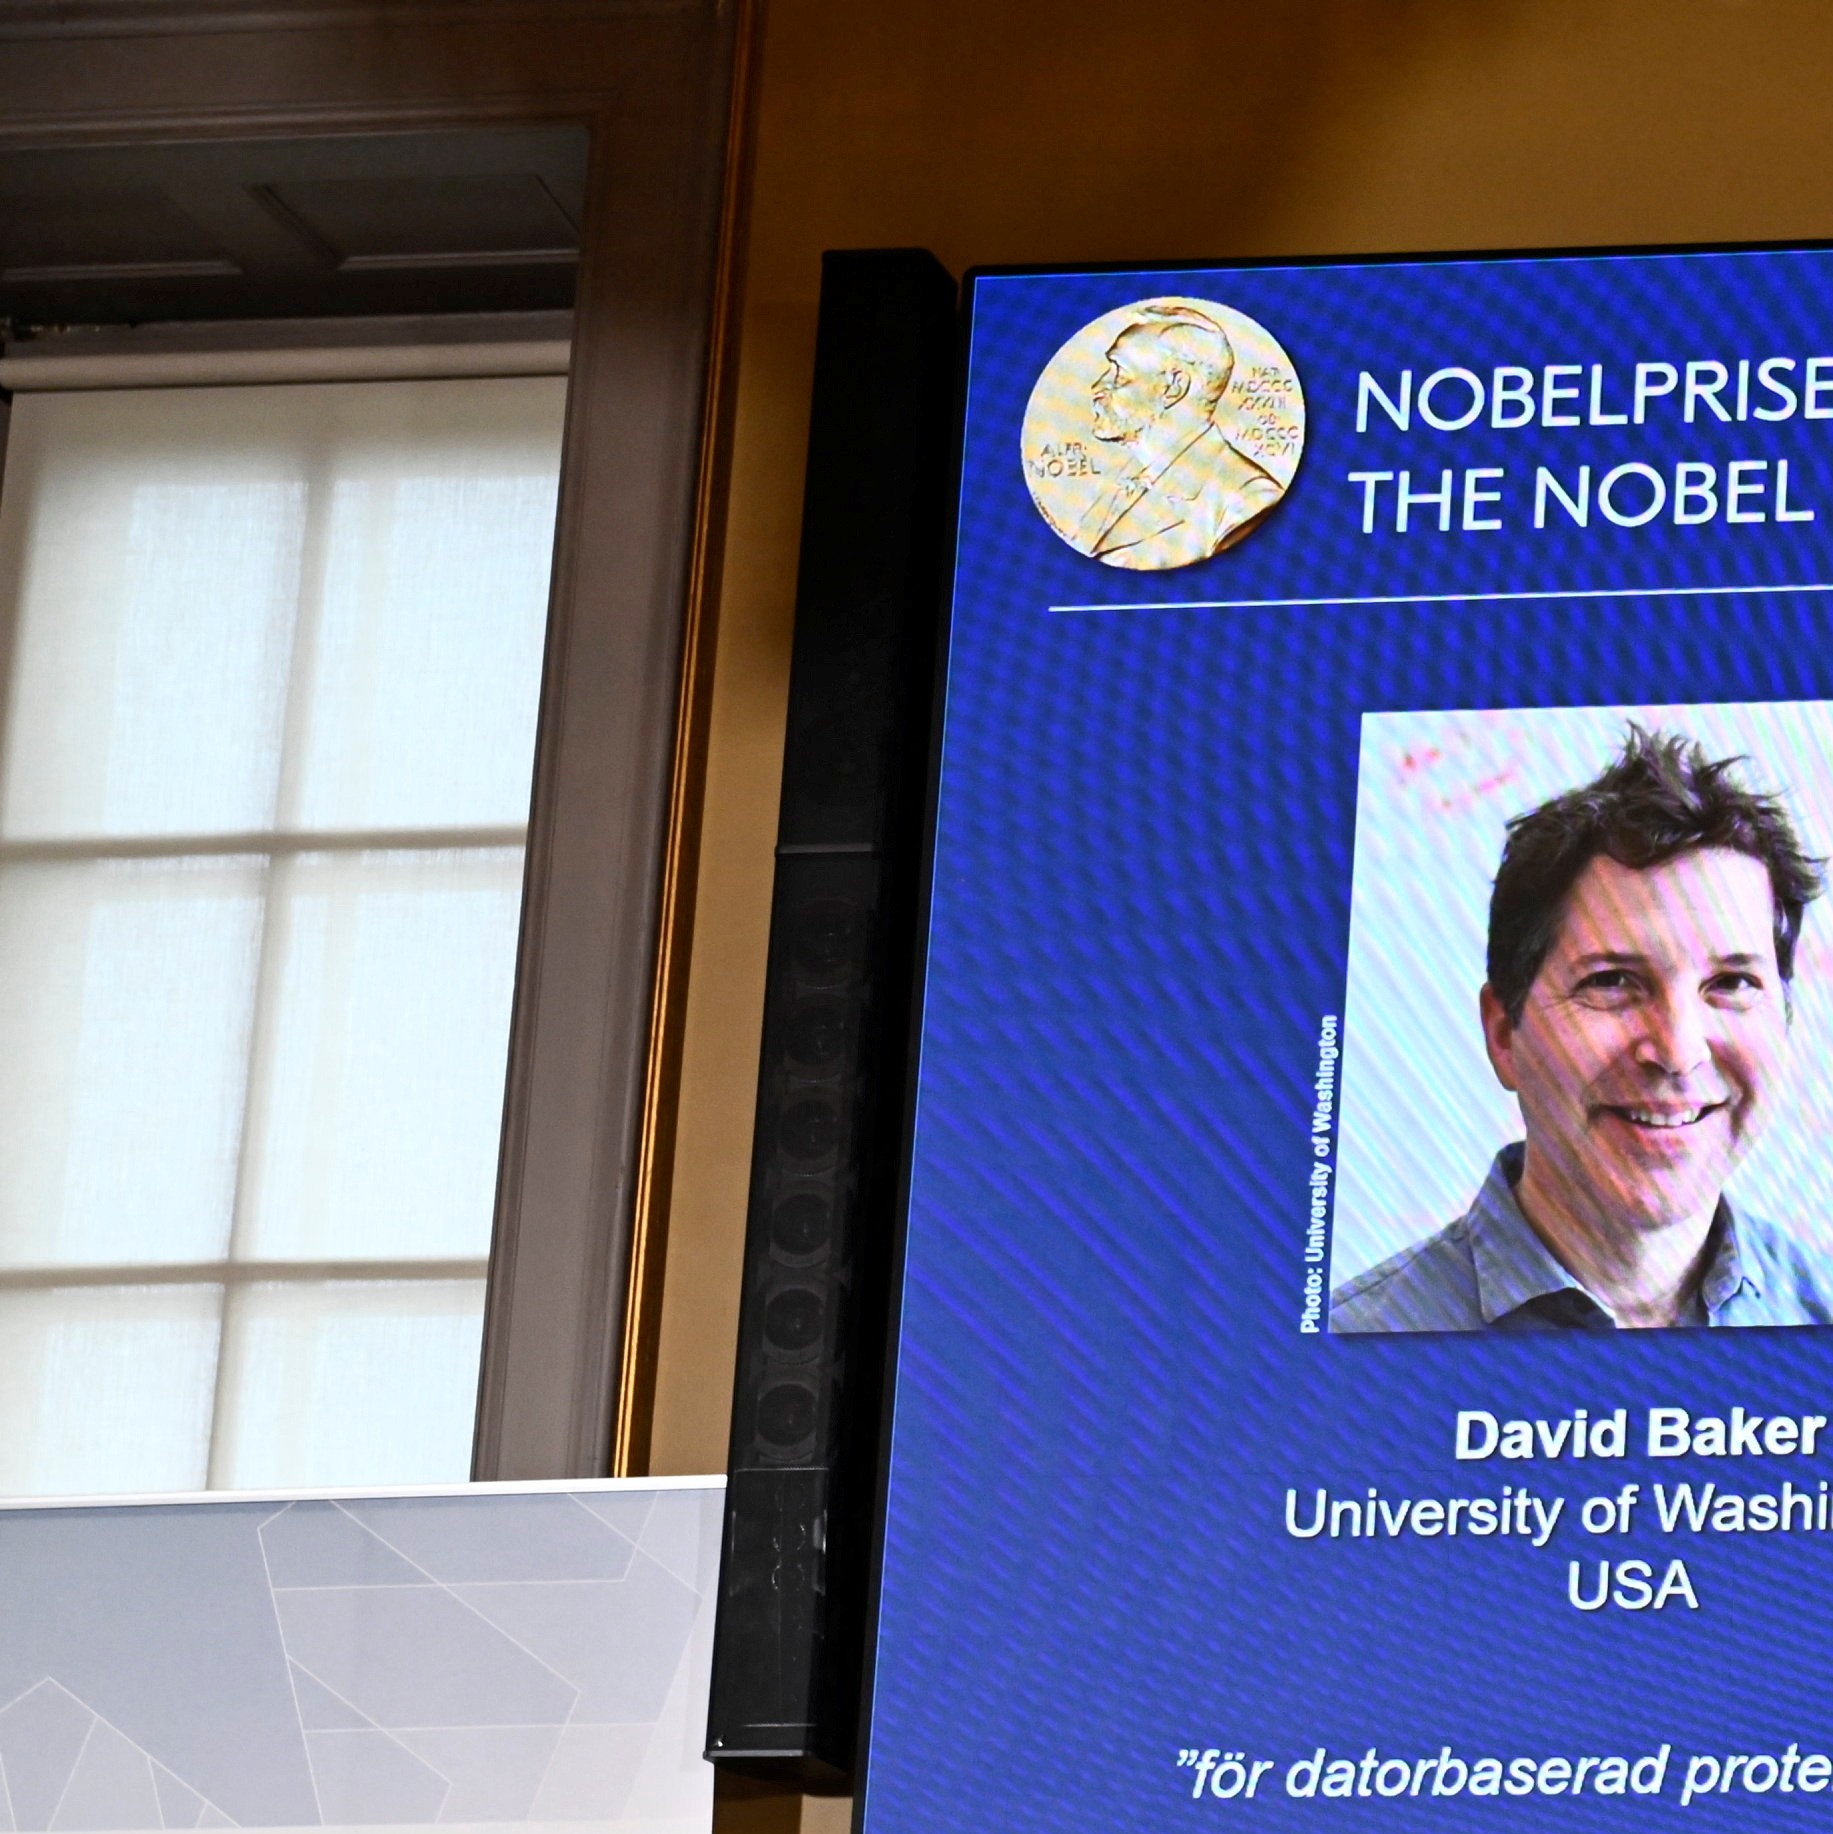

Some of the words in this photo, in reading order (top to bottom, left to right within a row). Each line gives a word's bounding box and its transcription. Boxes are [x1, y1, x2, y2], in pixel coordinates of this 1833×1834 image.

[1348, 469, 1503, 533] THE
[1535, 460, 1814, 528] NOBEL
[1311, 1014, 1339, 1135] Washington
[1311, 1137, 1331, 1157] of
[1305, 1161, 1333, 1263] University
[1300, 1267, 1324, 1334] Photo:
[1456, 1409, 1626, 1459] David
[1648, 1407, 1826, 1456] Baker
[1286, 1486, 1564, 1546] University
[1582, 1485, 1639, 1533] of
[1569, 1560, 1698, 1609] USA
[1177, 1750, 1274, 1798] ”för
[1286, 1745, 1670, 1797] datorbaserad
